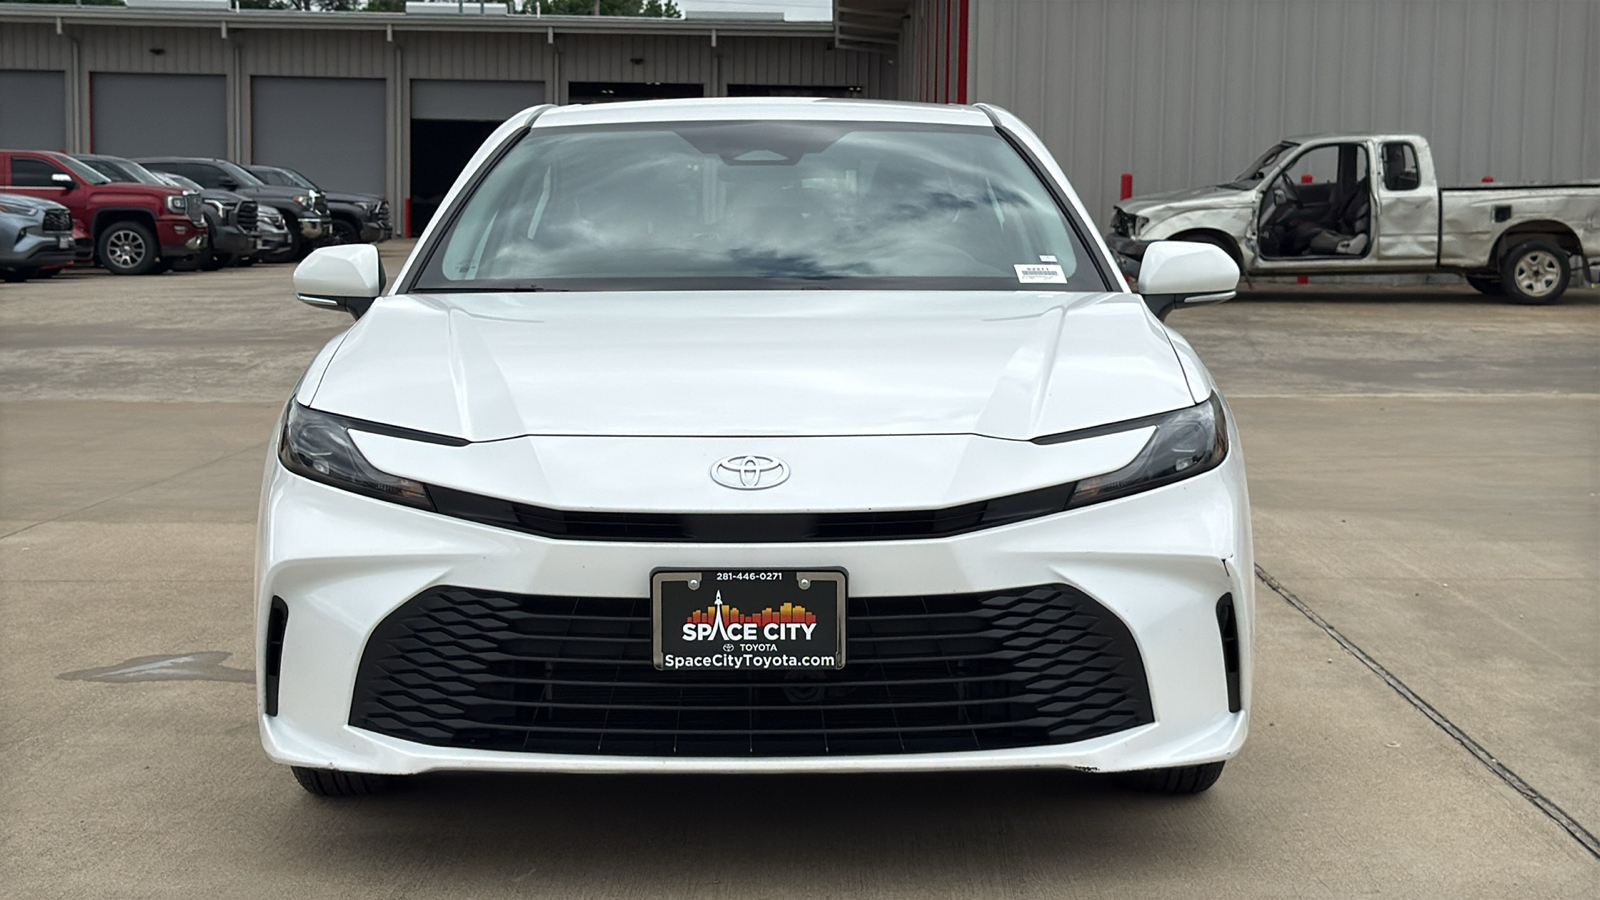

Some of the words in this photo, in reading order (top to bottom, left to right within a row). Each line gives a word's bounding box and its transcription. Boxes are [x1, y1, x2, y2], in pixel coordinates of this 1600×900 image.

[716, 573, 782, 581] 281-446-0271
[682, 623, 758, 641] SPACE
[763, 623, 817, 641] CITY
[740, 643, 778, 652] TOYOTA
[665, 654, 835, 669] SpaceCityToyota.com
